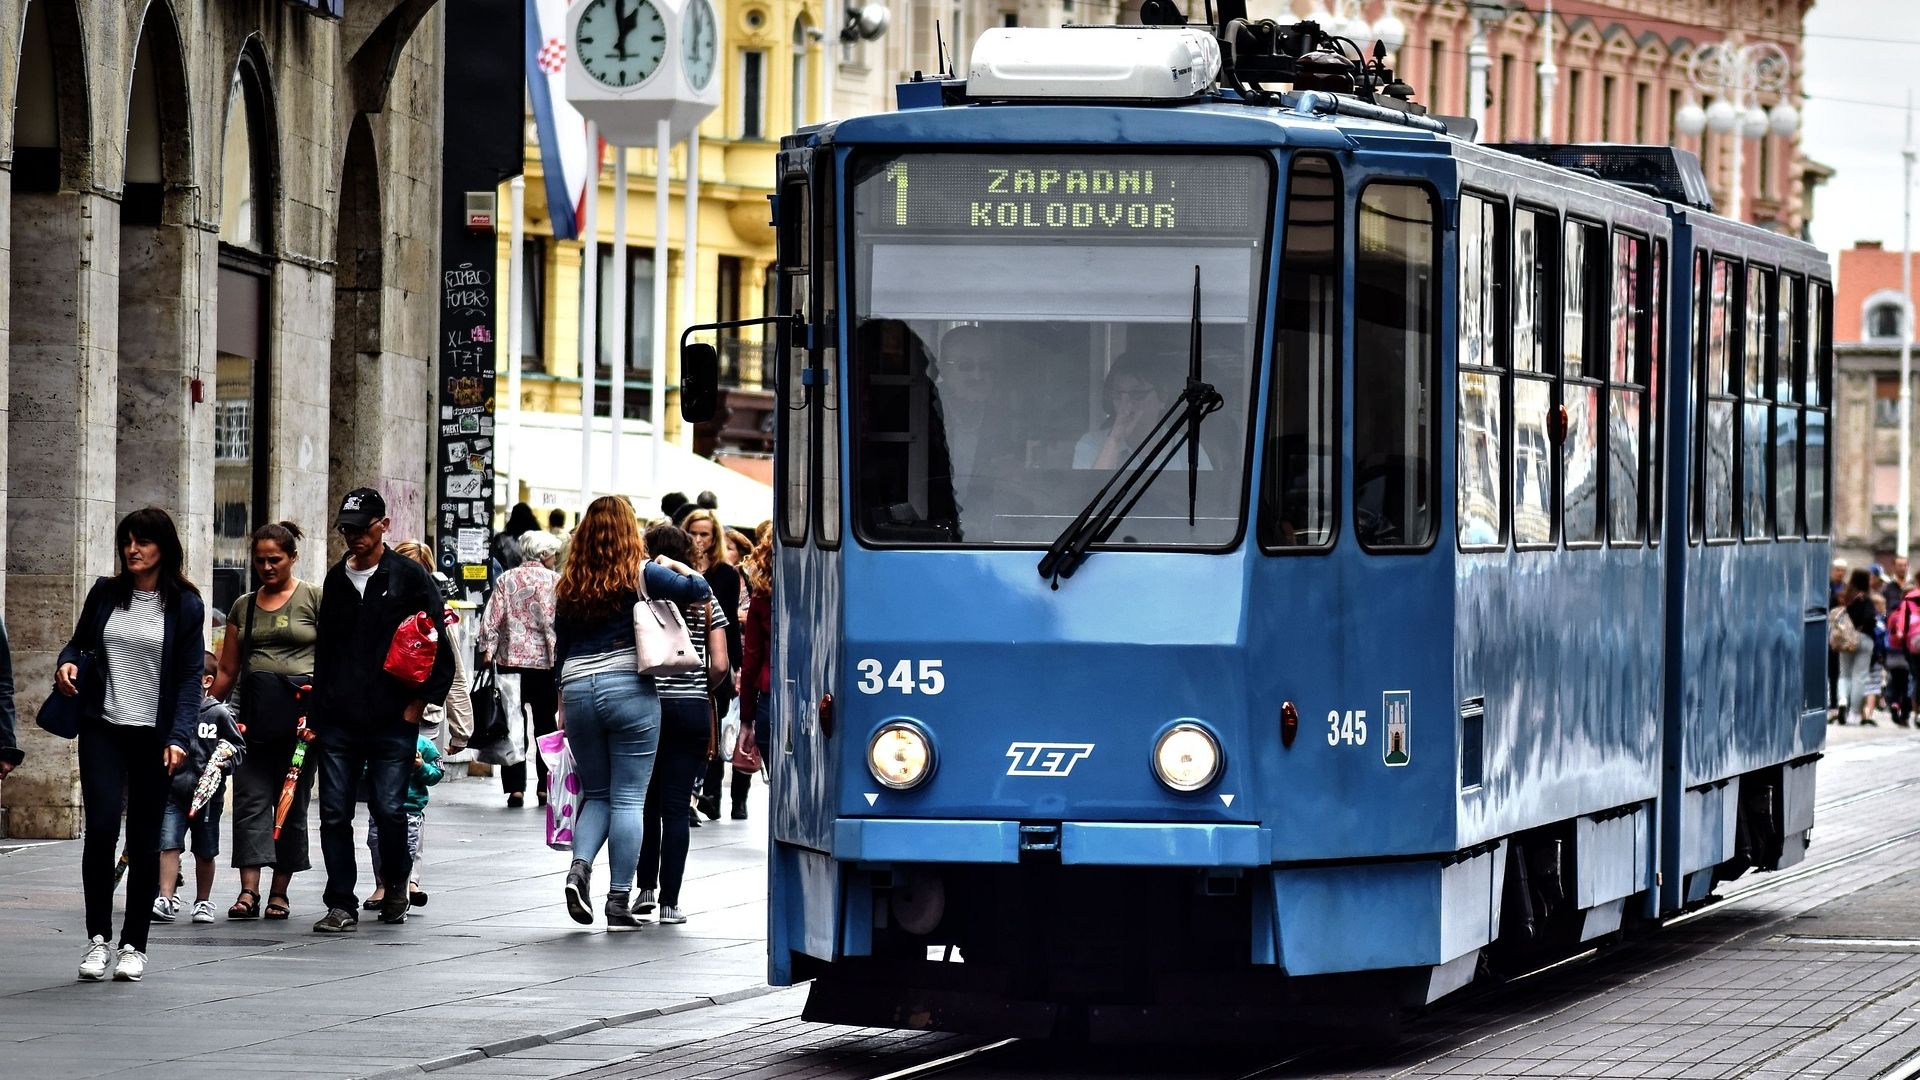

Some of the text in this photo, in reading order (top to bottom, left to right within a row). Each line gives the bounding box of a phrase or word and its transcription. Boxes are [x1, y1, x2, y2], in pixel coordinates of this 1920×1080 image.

[886, 161, 909, 226] 1
[987, 169, 1154, 194] ZAPADNI
[970, 202, 1176, 228] KOLODVOR
[857, 659, 945, 695] 345
[198, 722, 217, 739] 02
[1327, 710, 1367, 746] 345
[1006, 742, 1096, 777] ZET
